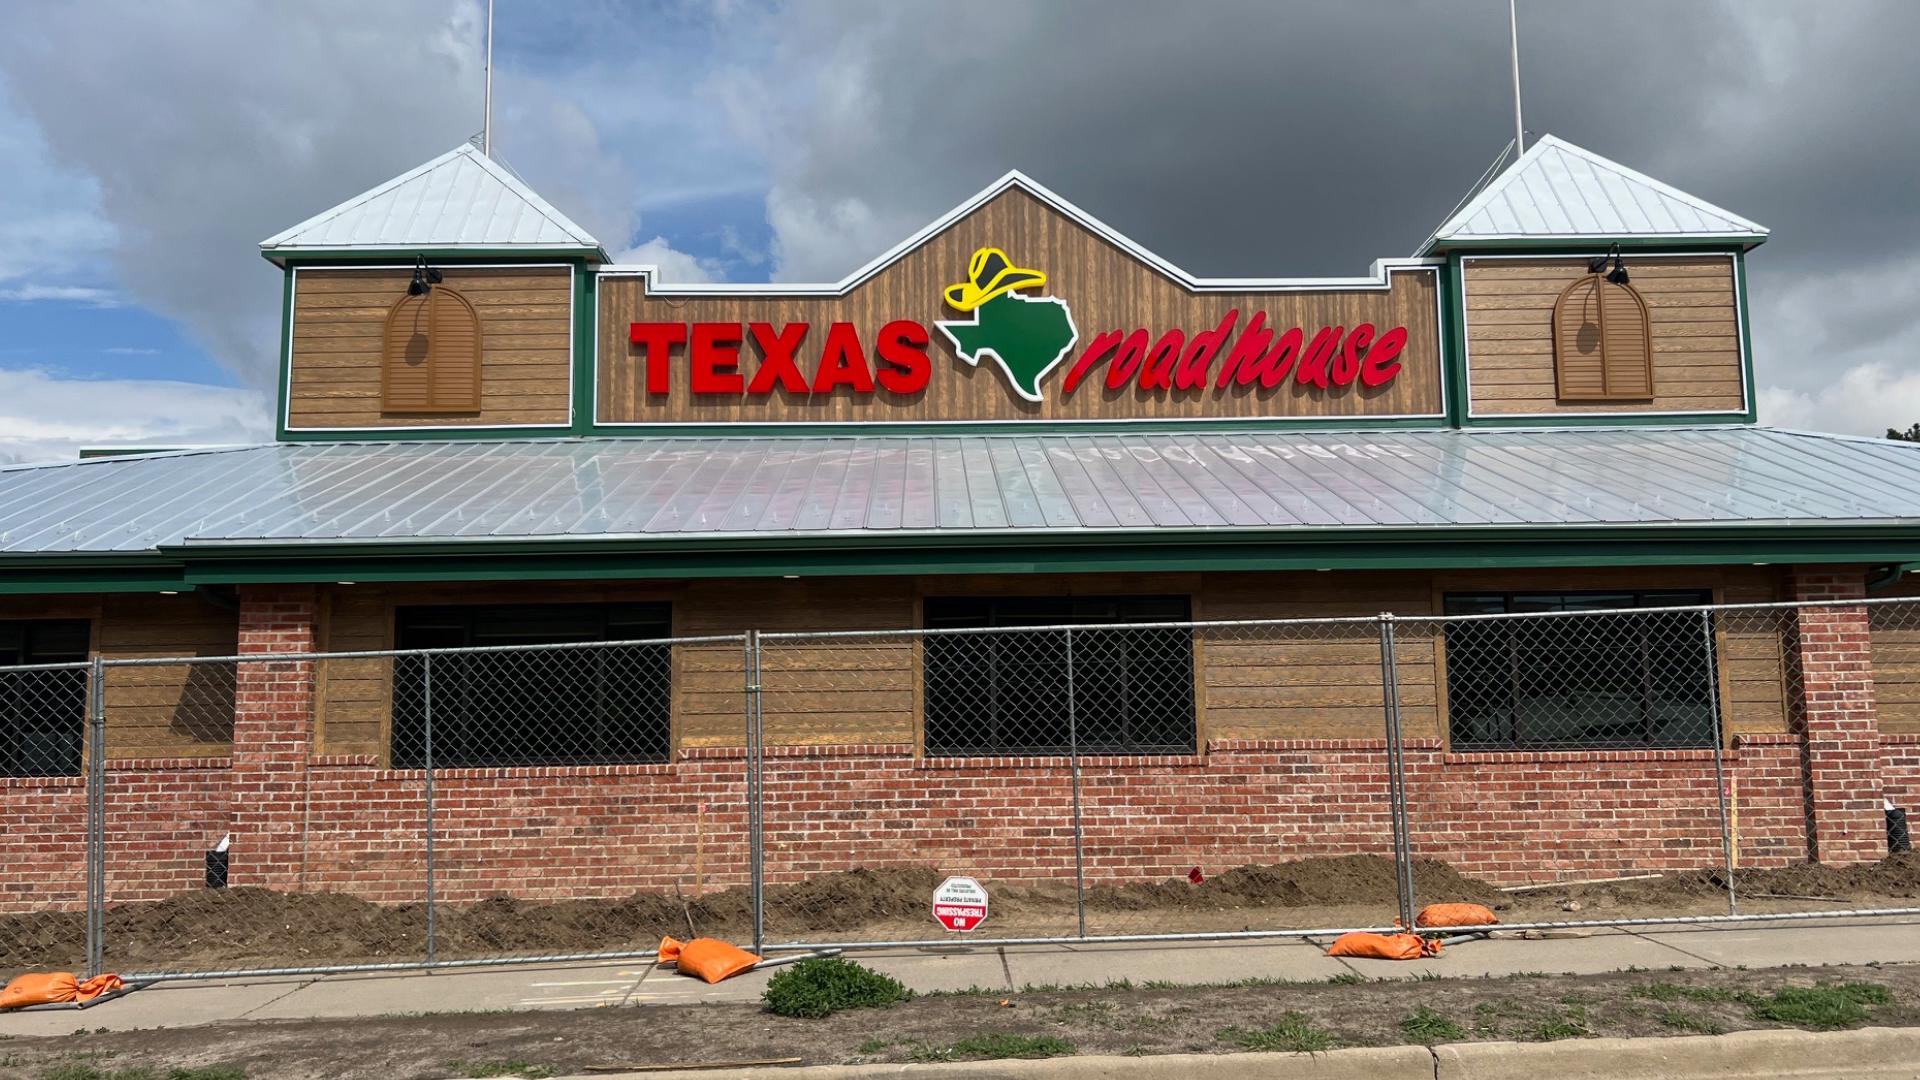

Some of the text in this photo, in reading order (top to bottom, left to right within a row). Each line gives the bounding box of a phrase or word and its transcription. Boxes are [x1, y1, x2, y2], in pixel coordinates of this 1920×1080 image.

[630, 310, 1407, 394] TEXAS roadhouse
[936, 907, 983, 918] TRESPASSING
[953, 917, 966, 927] NO
